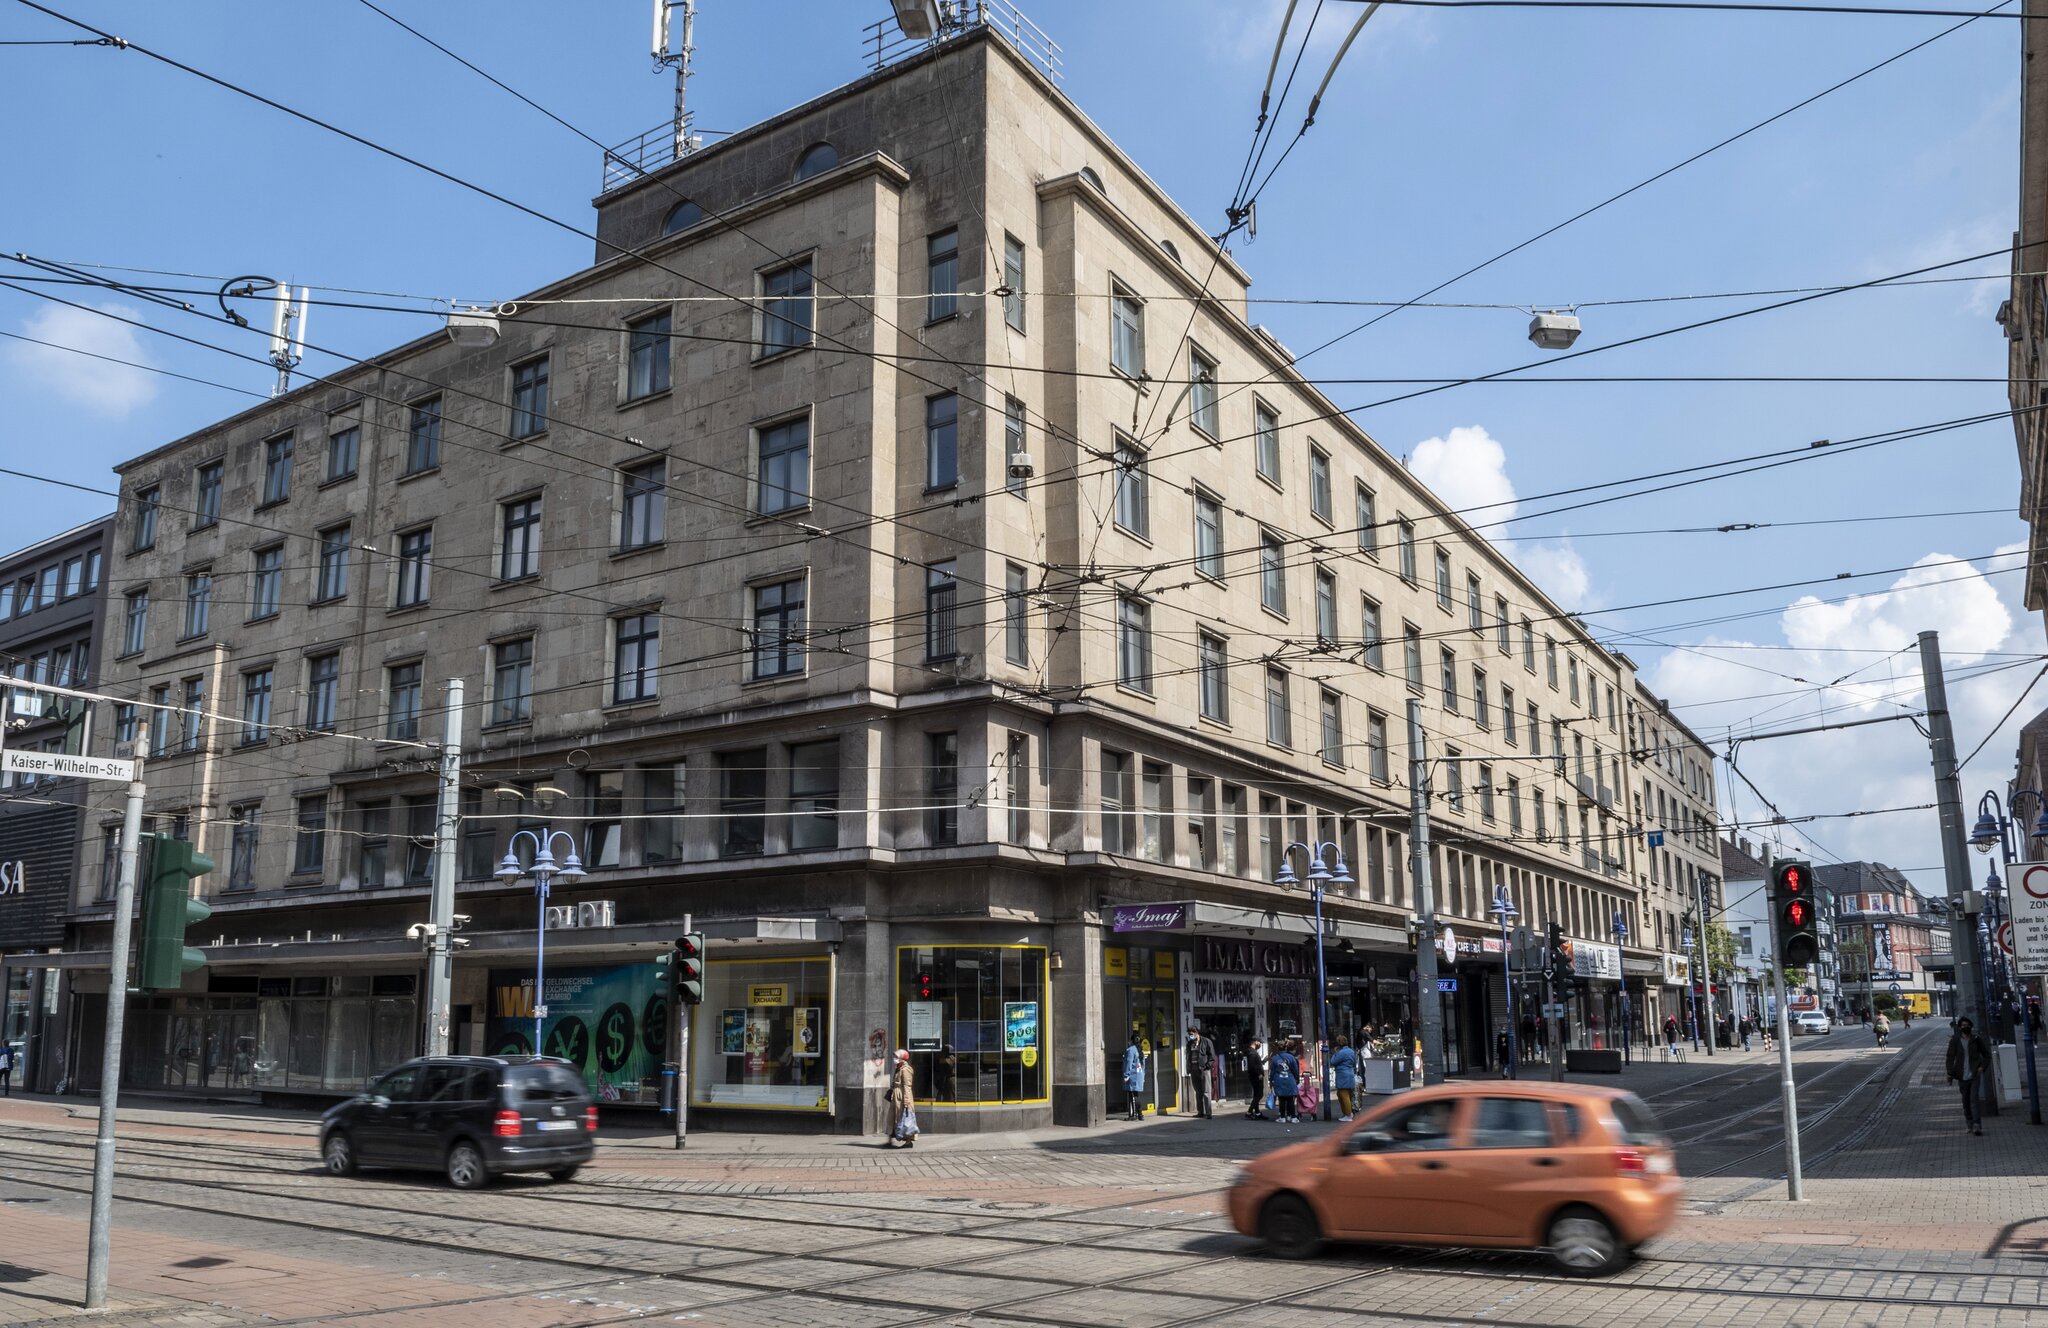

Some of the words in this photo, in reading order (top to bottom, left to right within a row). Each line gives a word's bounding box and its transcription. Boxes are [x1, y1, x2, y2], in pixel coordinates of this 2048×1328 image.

[11, 754, 125, 777] Kaiser-Wilhelm-Str.
[546, 977, 594, 986] GELDWECHSEL
[545, 985, 582, 993] EXCHANGE
